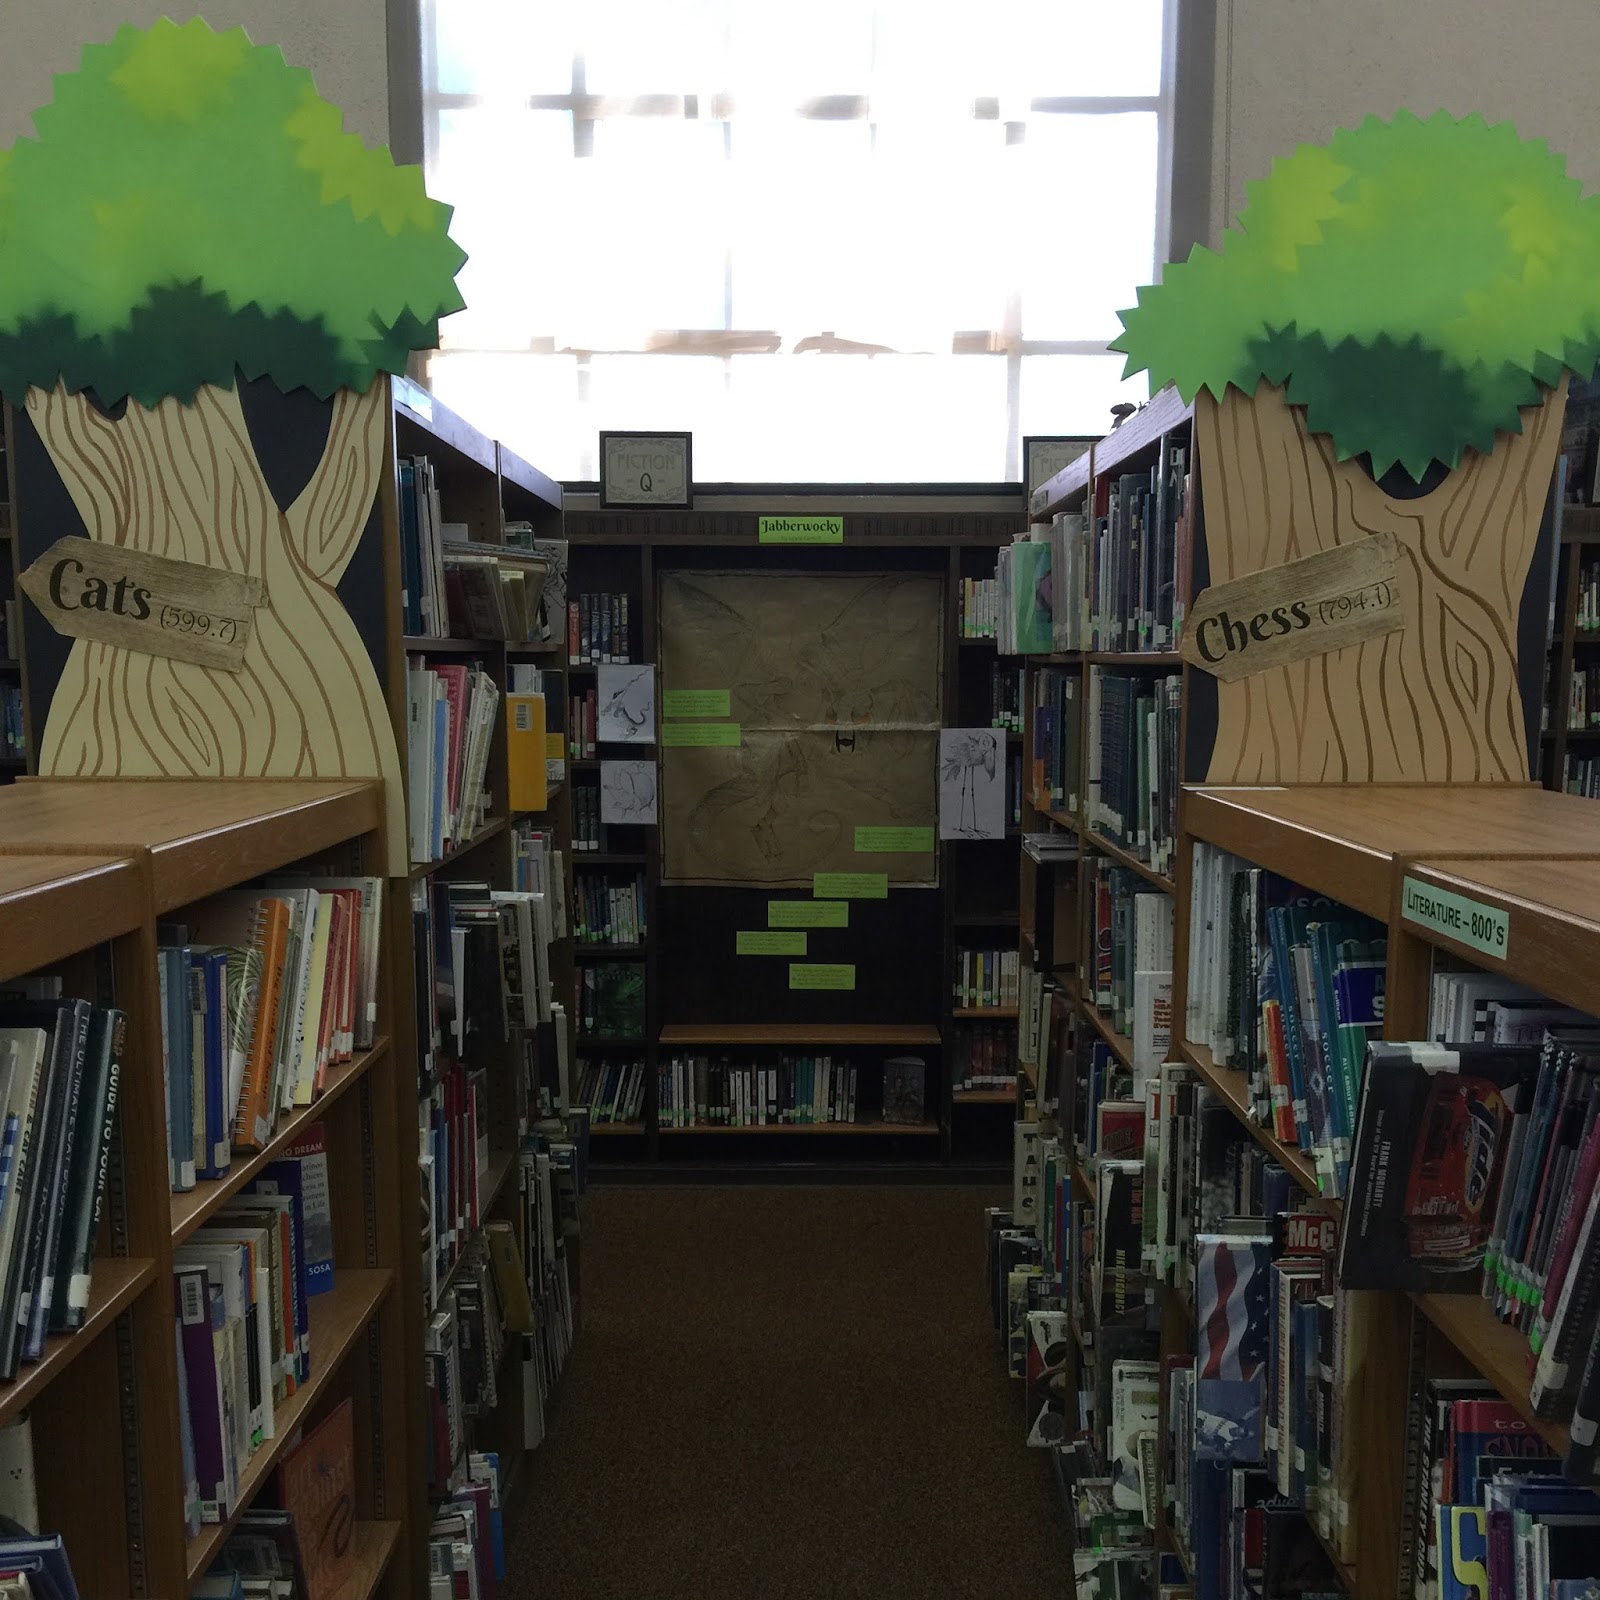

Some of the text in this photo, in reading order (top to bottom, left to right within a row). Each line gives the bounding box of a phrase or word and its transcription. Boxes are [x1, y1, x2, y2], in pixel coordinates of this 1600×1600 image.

[640, 472, 652, 492] Q
[761, 519, 841, 534] Jabberwocky
[49, 558, 237, 644] Cats (599.7)
[1195, 581, 1391, 663] Chess (794.1)
[79, 1015, 90, 1045] THE
[1288, 1005, 1299, 1060] soccer
[1322, 1032, 1333, 1093] soccer
[69, 1051, 85, 1129] ULTIMATE
[106, 1064, 120, 1113] GUIDE
[103, 1119, 113, 1141] TO
[294, 1142, 323, 1155] DREAM
[98, 1144, 110, 1191] YOUR
[1373, 1141, 1391, 1208] FRANK MORIARTY
[308, 1263, 331, 1276] SOSA
[1115, 1249, 1126, 1270] MIKE
[1423, 1416, 1432, 1451] THE
[1493, 1419, 1526, 1429] to
[1417, 1453, 1431, 1536] STANLEY
